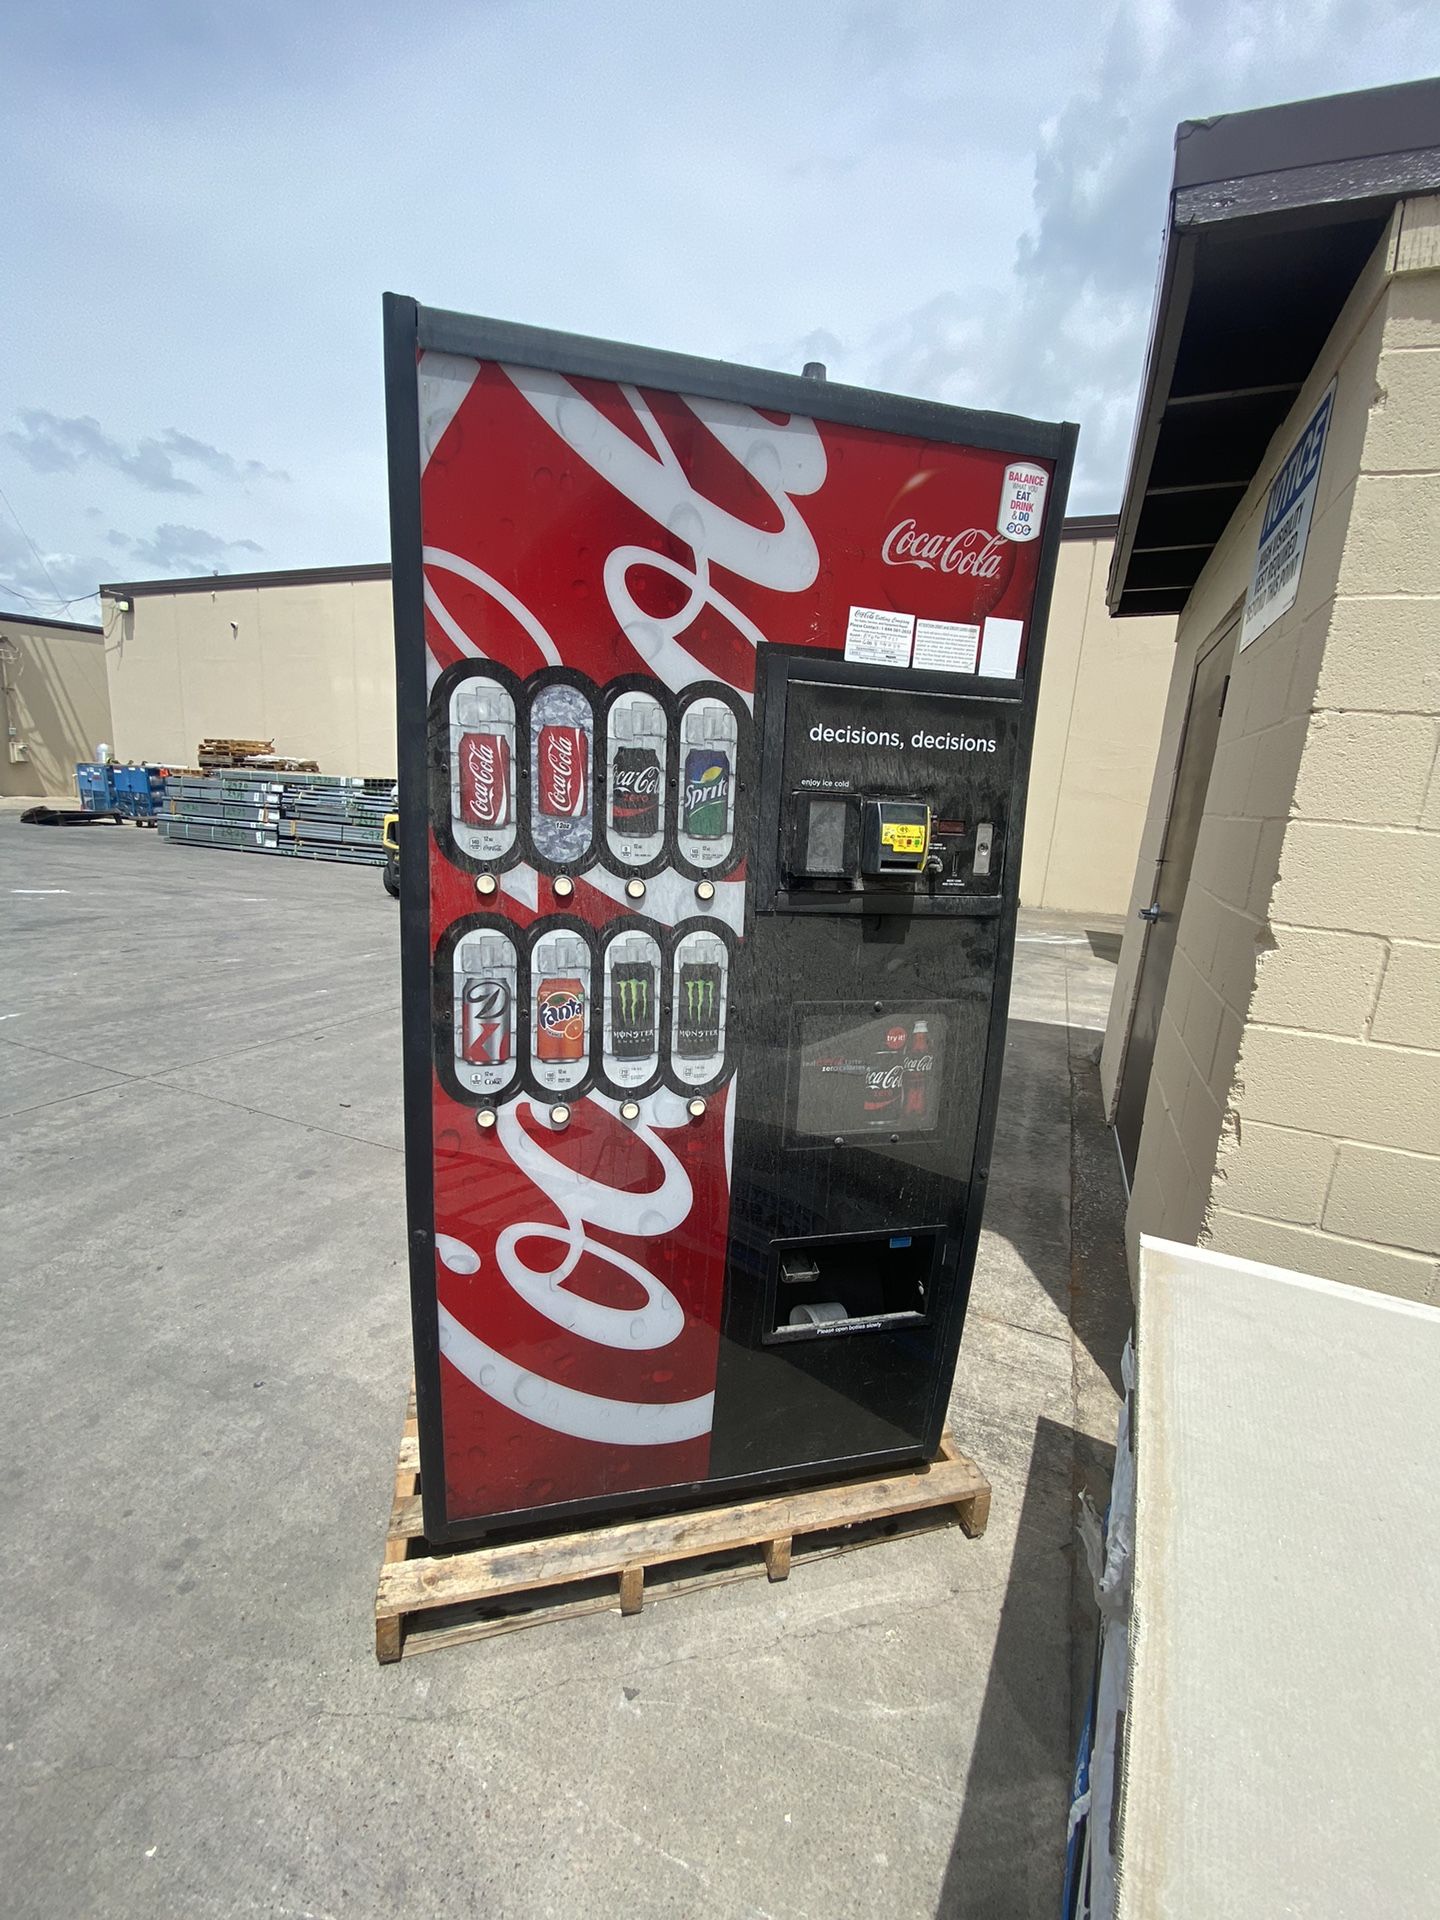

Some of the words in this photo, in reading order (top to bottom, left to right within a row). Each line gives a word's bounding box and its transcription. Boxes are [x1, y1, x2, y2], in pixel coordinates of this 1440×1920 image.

[1008, 471, 1045, 486] BALANCE
[1262, 408, 1328, 537] NOTICE
[1012, 482, 1027, 490] WHAT
[1028, 484, 1038, 493] YOU
[1016, 491, 1031, 501] EAT
[1010, 500, 1034, 512] DRINK
[1011, 511, 1017, 520] &
[1018, 512, 1030, 522] DO
[882, 519, 1008, 578] Coca-Cola
[1268, 531, 1299, 582] REQUIRED
[1280, 553, 1301, 593] POINT
[809, 723, 905, 750] decisions,
[911, 730, 996, 753] decisions
[547, 731, 573, 812] Coca-Cola
[468, 739, 495, 821] Coca-Cola
[801, 779, 821, 787] enjoy
[822, 779, 833, 787] ice
[834, 780, 850, 788] cold
[540, 997, 584, 1030] Fanta
[613, 1029, 654, 1039] MONSTER
[679, 1028, 719, 1039] MONSTER
[816, 1326, 835, 1335] Please
[835, 1325, 848, 1334] open
[866, 1321, 882, 1330] slowly
